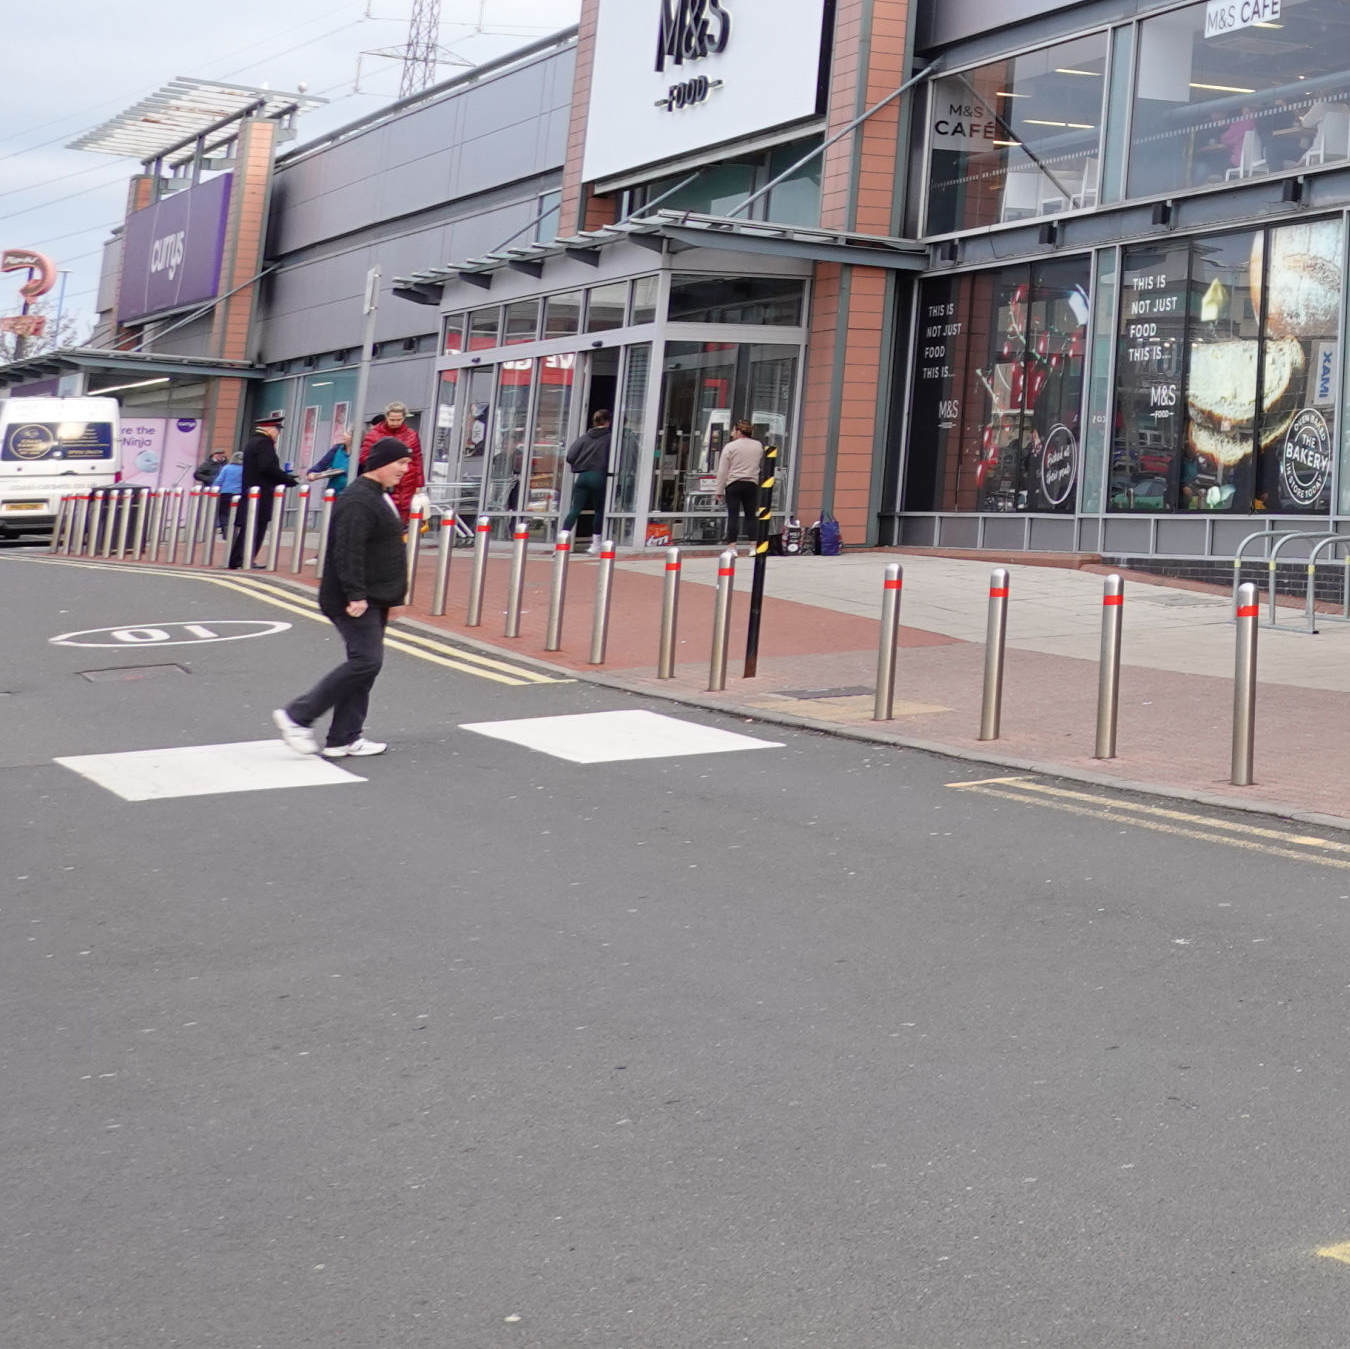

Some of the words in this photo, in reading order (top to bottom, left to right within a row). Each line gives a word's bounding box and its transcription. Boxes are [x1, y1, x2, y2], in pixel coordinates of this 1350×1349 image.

[1207, 5, 1236, 34] M&S
[667, 75, 709, 112] FOOD
[949, 104, 983, 118] M&S
[935, 121, 995, 139] CAFÉ
[151, 231, 184, 281] currys
[1133, 276, 1154, 291] THIS
[1157, 274, 1167, 289] IS
[928, 305, 945, 317] THIS
[946, 303, 955, 315] IS
[1131, 300, 1151, 314] NOT
[1154, 297, 1178, 312] JUST
[926, 325, 941, 338] NOT
[942, 323, 962, 336] JUST
[1130, 323, 1157, 338] FOOD
[924, 346, 946, 359] FOOD
[1128, 348, 1150, 362] THIS
[923, 367, 940, 379] THIS
[1151, 385, 1176, 407] M&S
[938, 399, 959, 419] M&S
[1294, 414, 1310, 432] OVEN
[1302, 434, 1316, 448] THE
[1286, 442, 1328, 471] BAKERY
